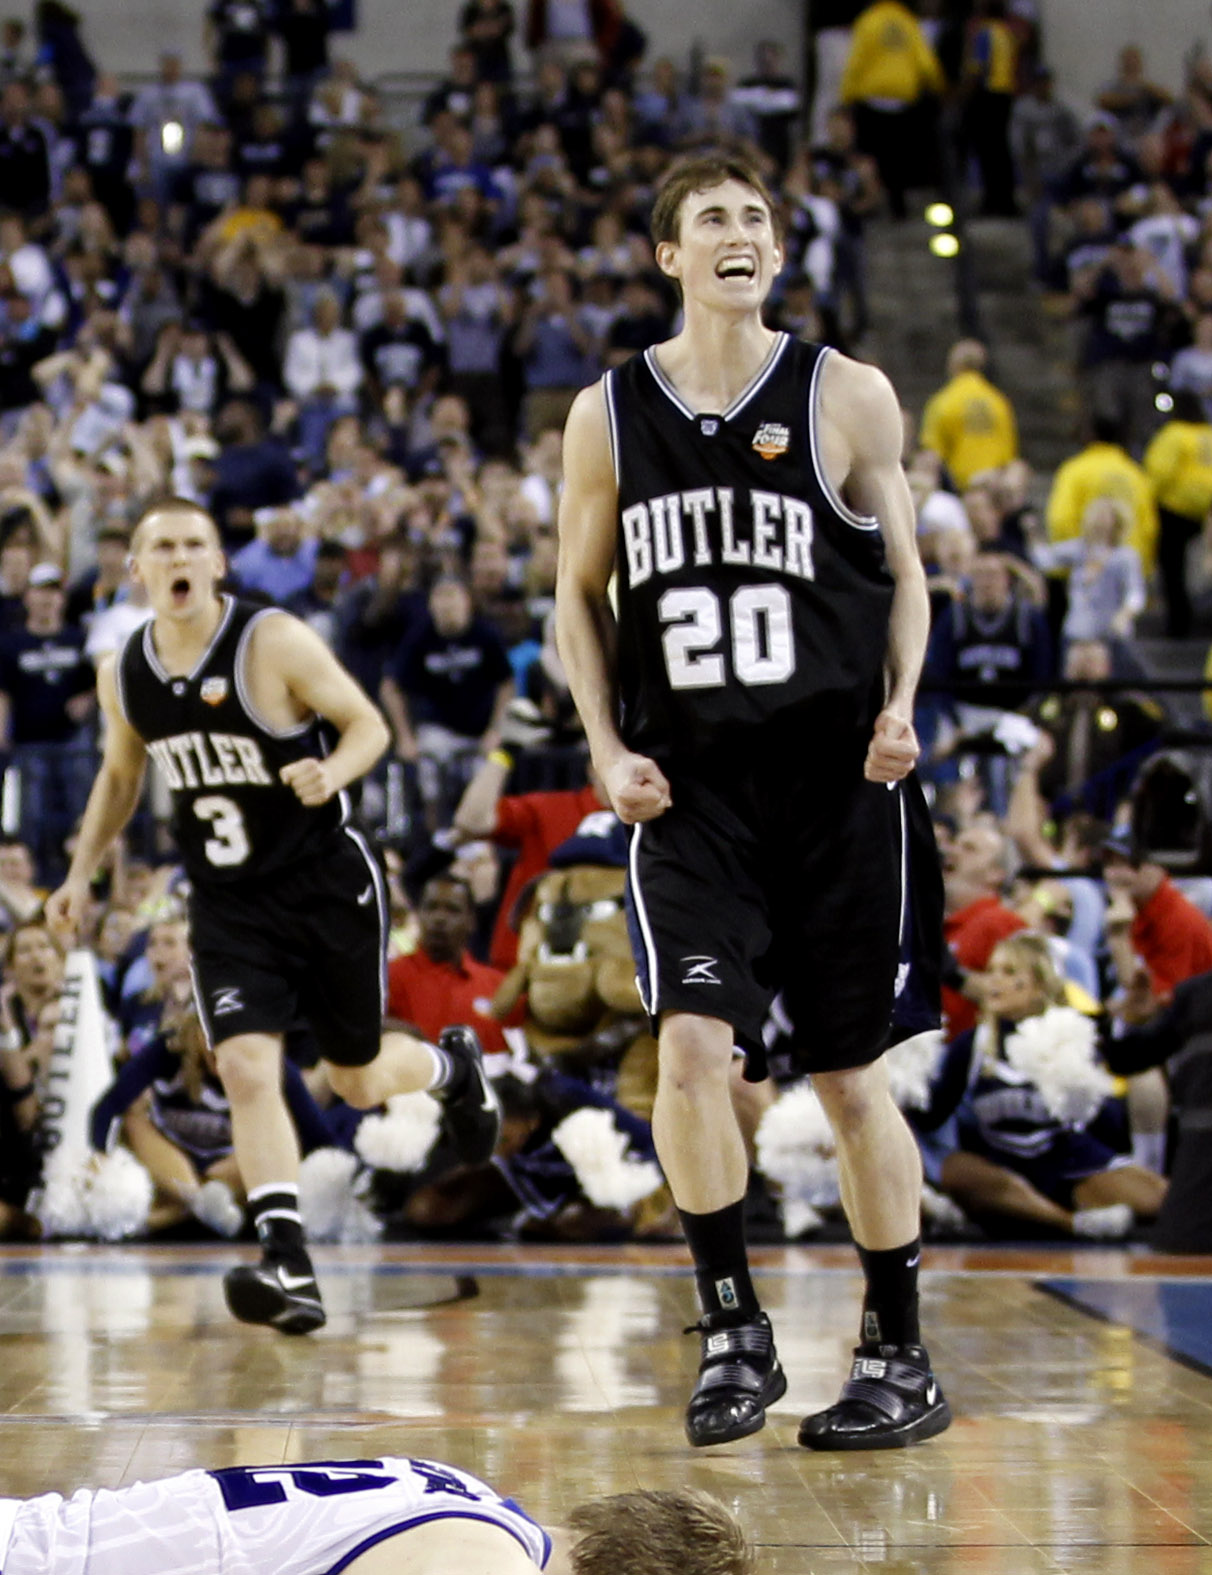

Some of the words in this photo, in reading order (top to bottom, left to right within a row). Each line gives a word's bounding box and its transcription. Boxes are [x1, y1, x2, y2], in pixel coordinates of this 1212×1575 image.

[752, 430, 790, 447] FOUR
[764, 423, 790, 436] FINAL
[621, 486, 815, 589] BUTLER
[657, 583, 796, 690] 20
[145, 731, 274, 791] UTLER
[193, 795, 250, 866] 3
